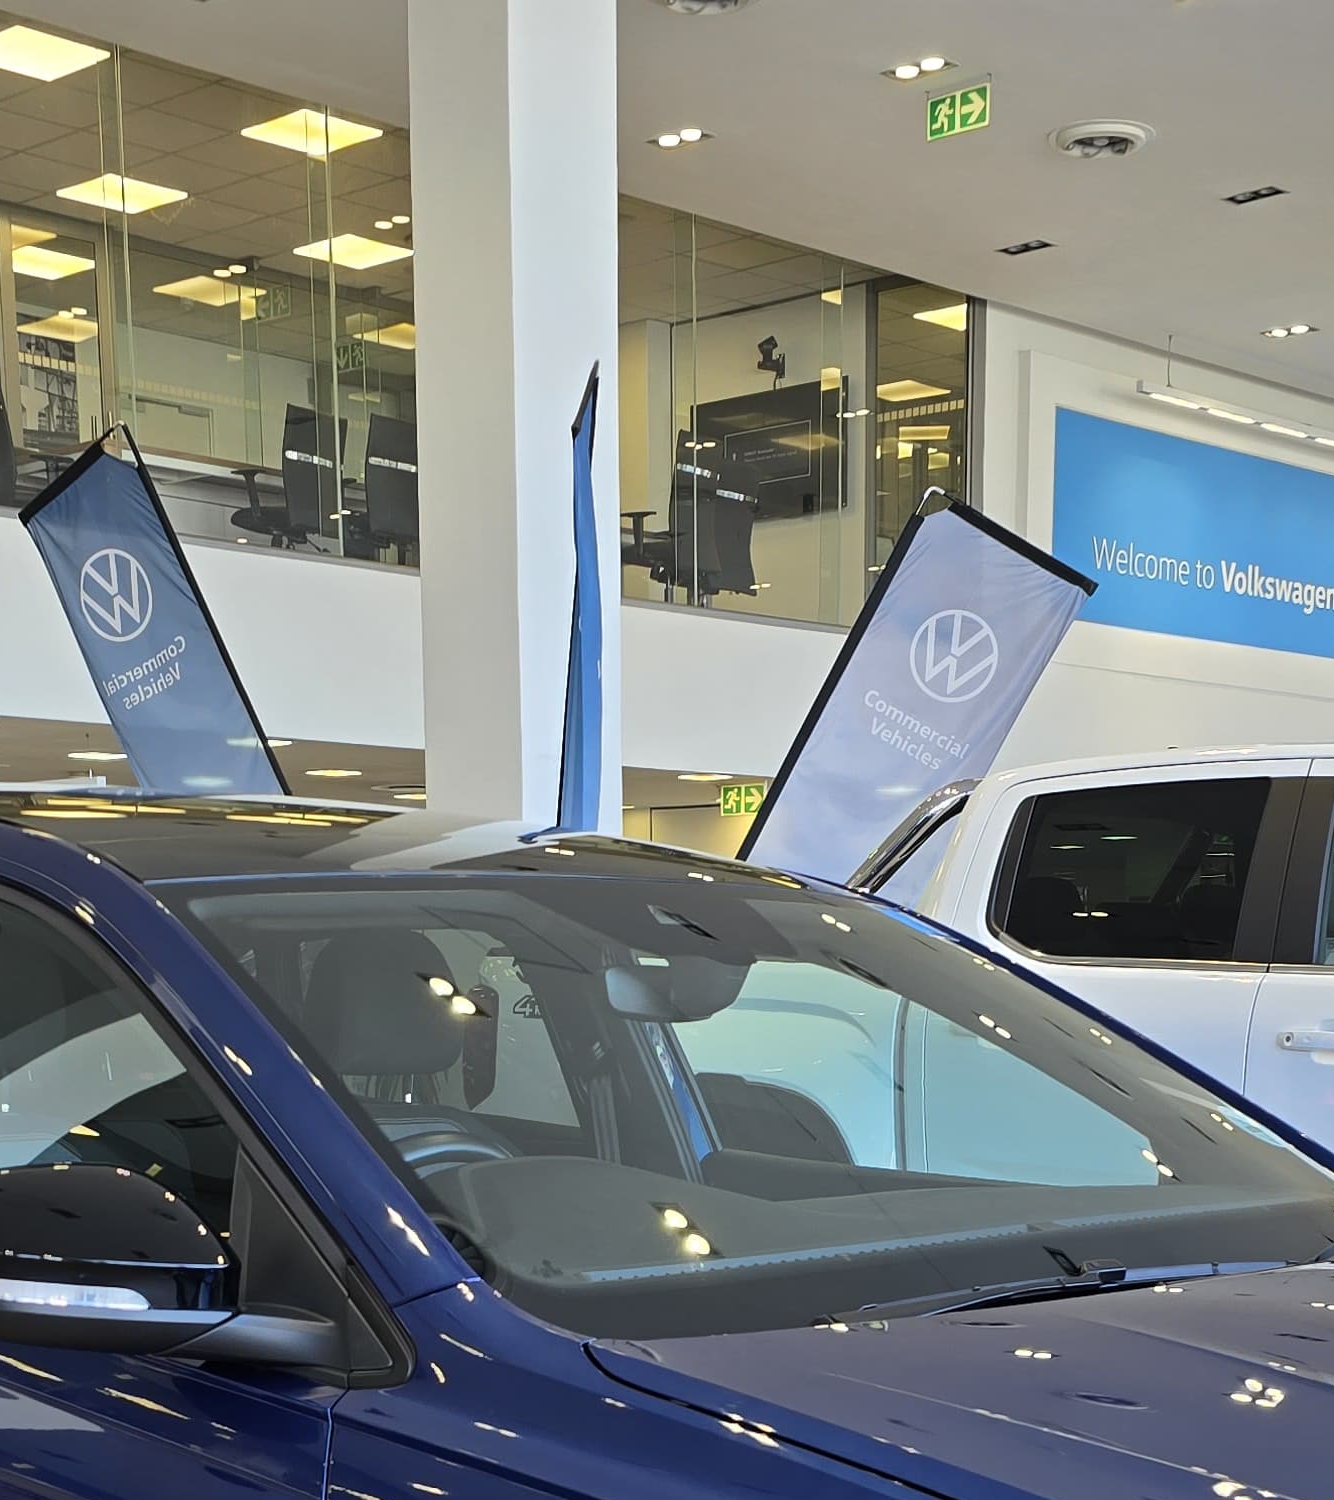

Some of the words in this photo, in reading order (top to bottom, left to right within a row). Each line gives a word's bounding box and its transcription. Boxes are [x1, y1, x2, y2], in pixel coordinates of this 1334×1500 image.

[1092, 535, 1190, 586] Welcome
[1196, 559, 1215, 589] to
[864, 689, 970, 760] Commercial
[870, 719, 942, 771] Vehicles
